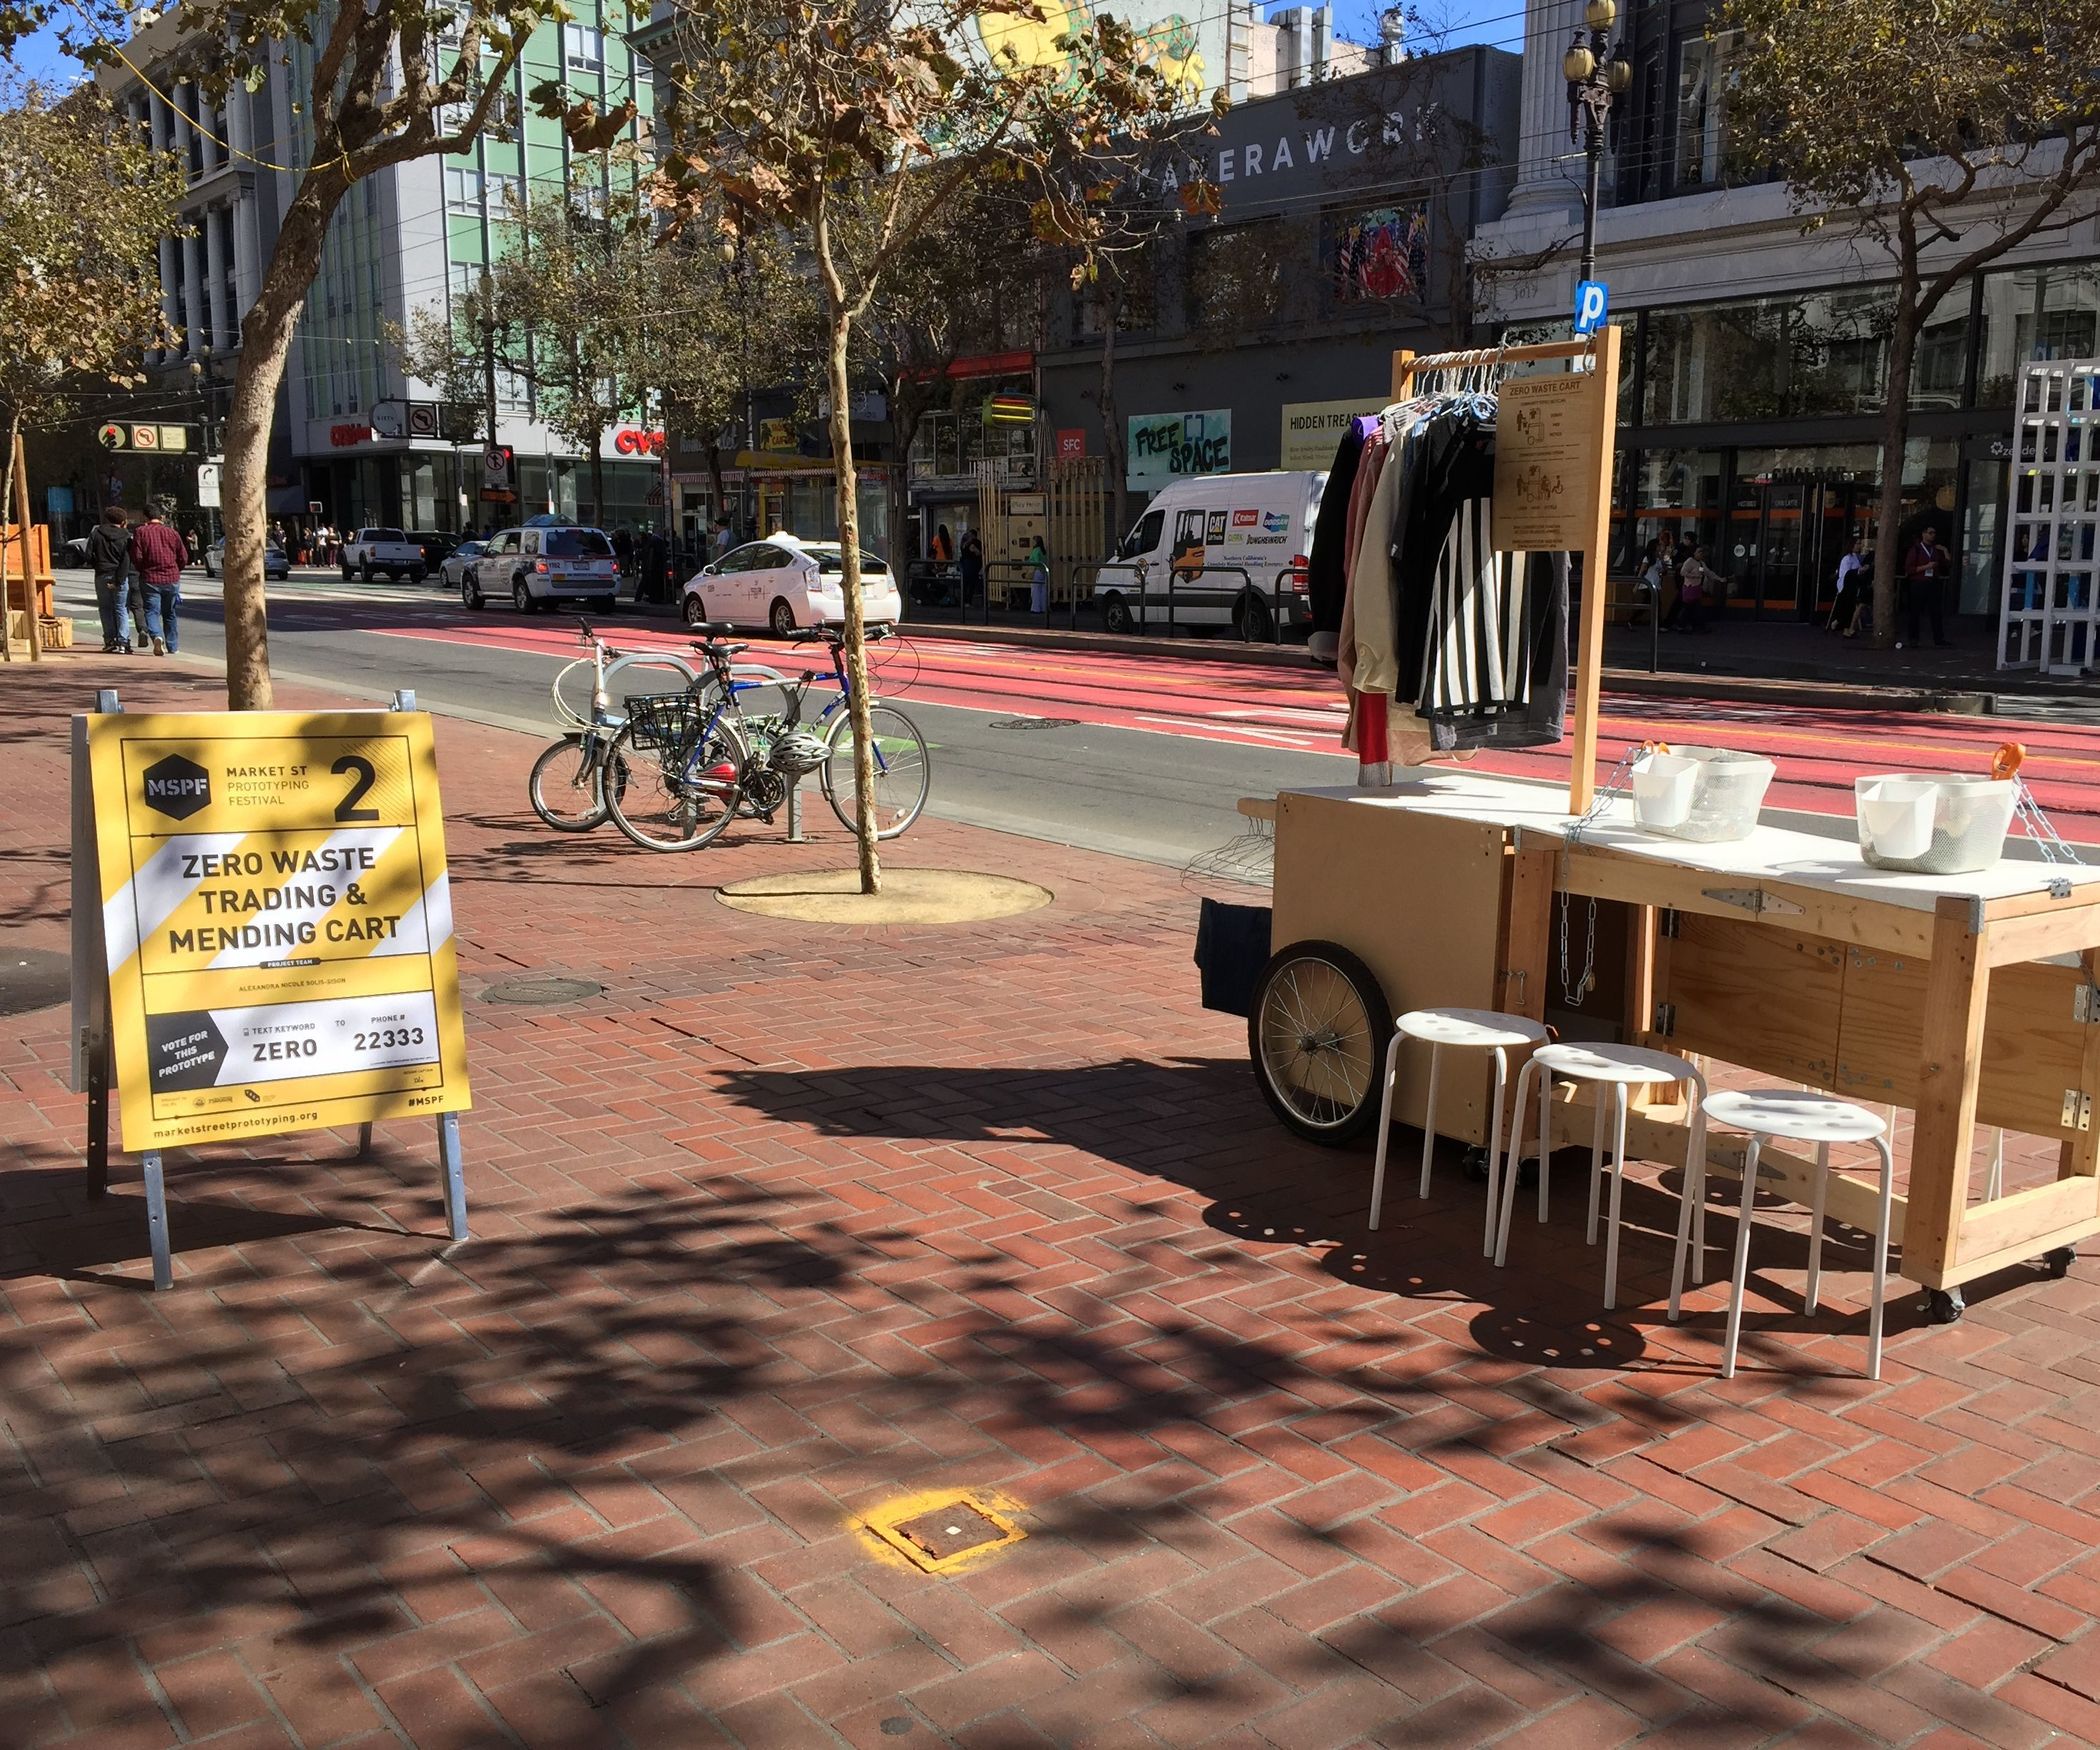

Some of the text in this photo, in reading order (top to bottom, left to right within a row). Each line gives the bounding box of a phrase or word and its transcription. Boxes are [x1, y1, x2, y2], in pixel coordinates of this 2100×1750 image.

[1509, 381, 1581, 396] ZERO WASTE CART
[1290, 414, 1325, 431] HIDDEN
[1063, 438, 1081, 451] SFC
[1134, 421, 1181, 457] FREE
[1168, 435, 1230, 474] SPACE
[2003, 444, 2049, 456] zedek
[1208, 516, 1226, 532] CAT
[226, 765, 308, 777] MARKET ST
[147, 779, 209, 797] MSPF
[227, 780, 310, 792] PROTOTYPING
[330, 754, 381, 823] 2
[228, 795, 286, 807] FESTIVAL
[181, 846, 376, 879] ZERO WASTE
[198, 882, 368, 915] TRADING &
[169, 915, 401, 954] MENDING CART
[267, 961, 295, 969] PROJECT
[239, 983, 281, 992] ALEXANDRA
[281, 980, 305, 988] NICOLE
[335, 1018, 346, 1027] TO
[370, 1014, 398, 1025] PHONE
[252, 1022, 316, 1036] TEXT KEYWORD
[161, 1029, 209, 1053] VOTE FOR
[353, 1026, 425, 1052] 22333
[174, 1045, 199, 1061] THIS
[253, 1038, 318, 1063] ZERO
[158, 1051, 216, 1079] PROTOTYPE
[408, 1095, 445, 1107] #MSPF
[153, 1111, 319, 1138] marketstreetprototyping.org
